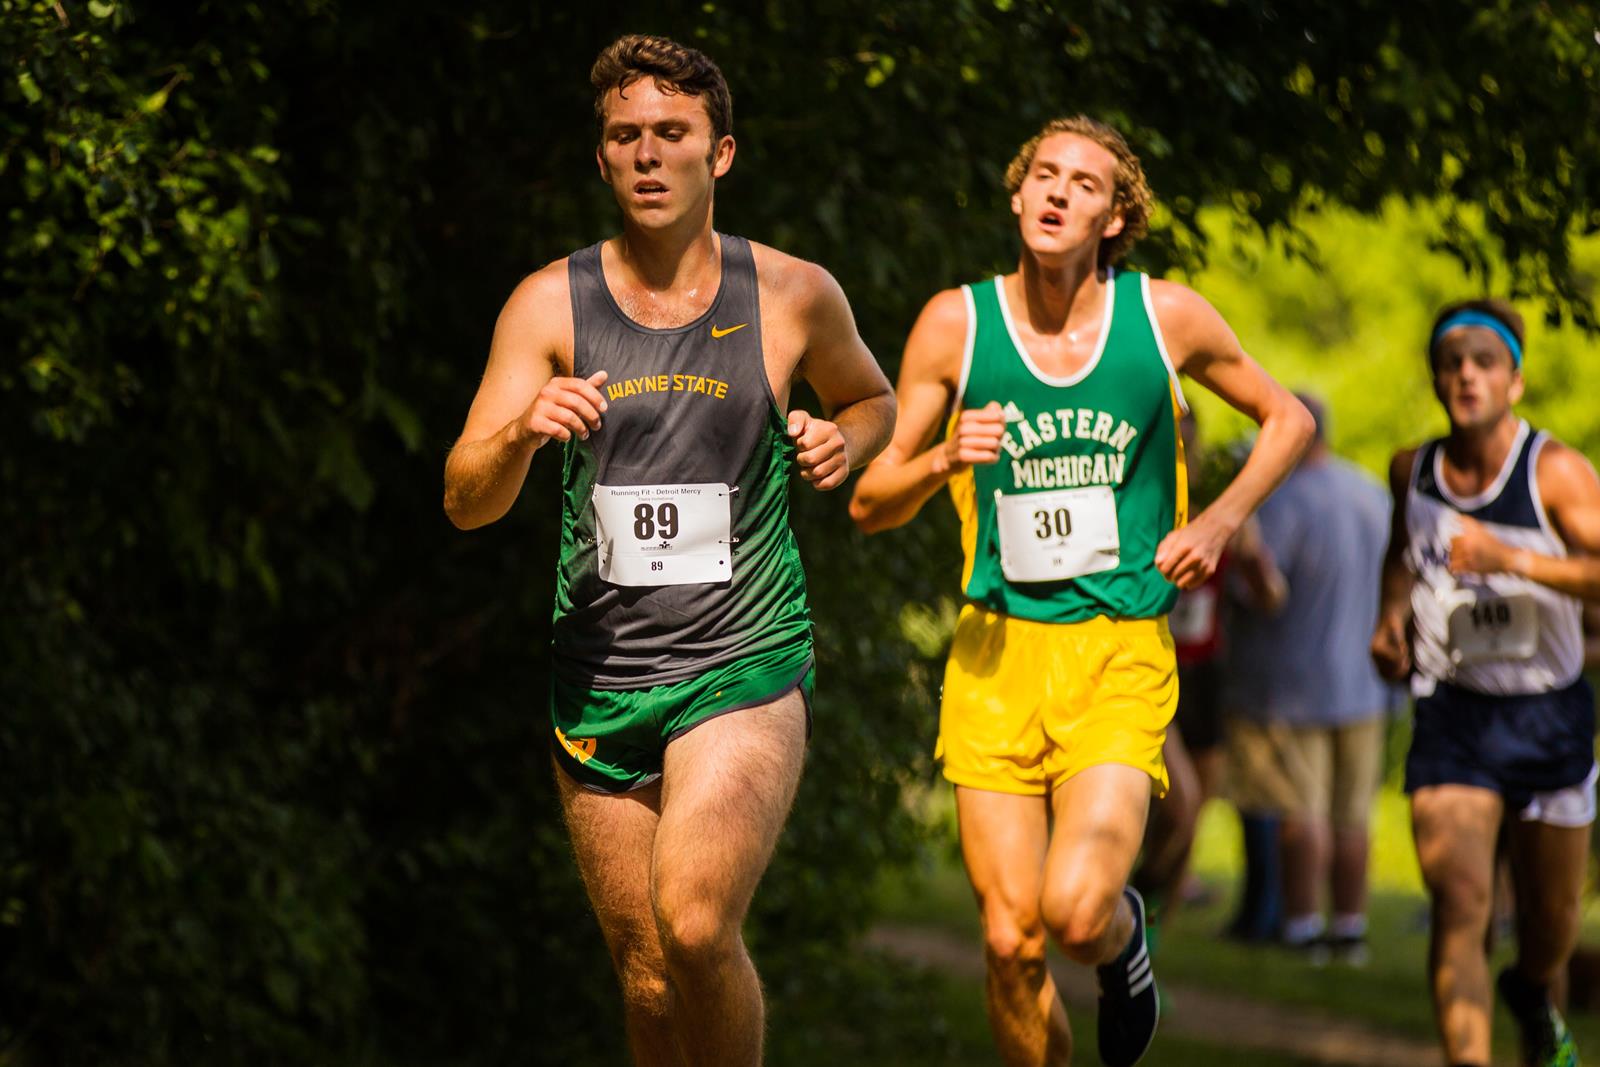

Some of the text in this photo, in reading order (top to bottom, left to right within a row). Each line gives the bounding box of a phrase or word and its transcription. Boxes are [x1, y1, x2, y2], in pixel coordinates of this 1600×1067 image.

[607, 374, 729, 401] WAYNE STATE
[999, 408, 1138, 460] EASTERN
[1011, 453, 1126, 489] MICHIGAN
[610, 489, 640, 497] Running
[680, 487, 702, 495] Mercy
[633, 503, 679, 540] 89
[1034, 508, 1072, 539] 30
[651, 561, 663, 571] 89
